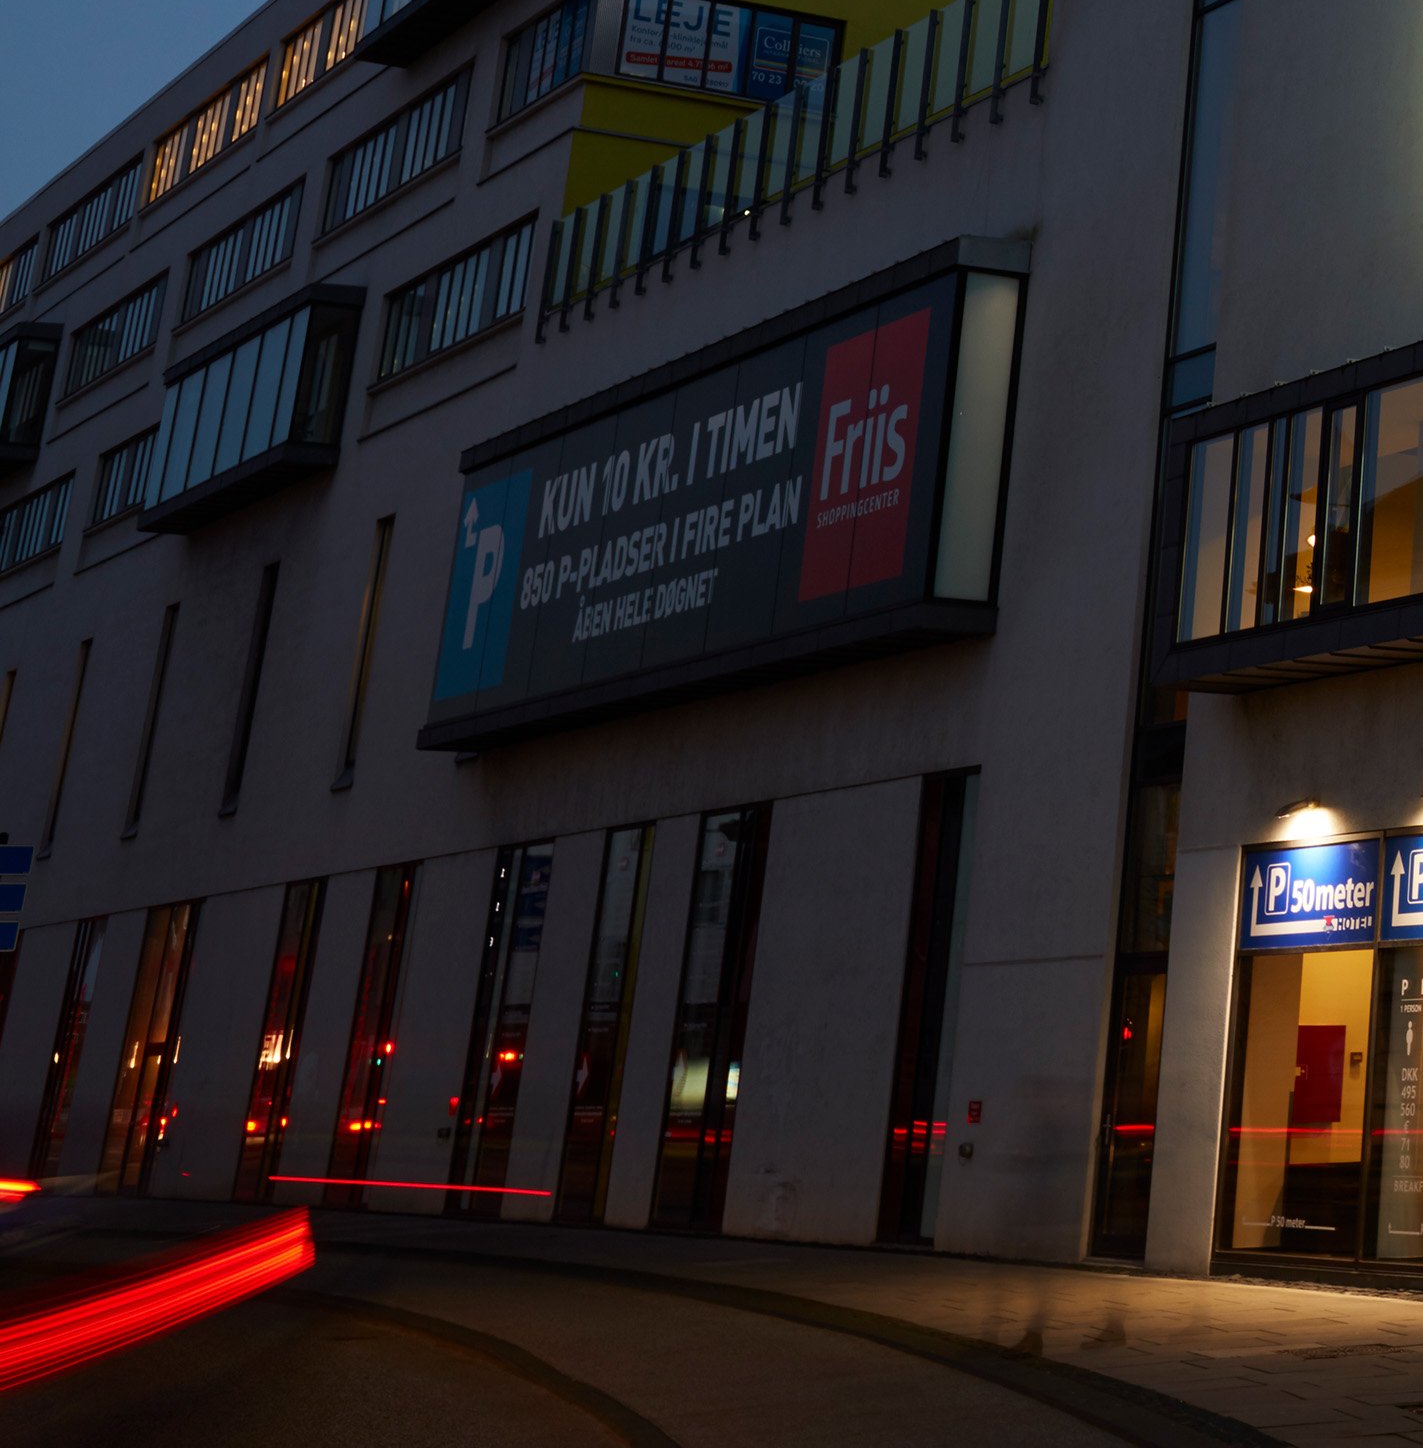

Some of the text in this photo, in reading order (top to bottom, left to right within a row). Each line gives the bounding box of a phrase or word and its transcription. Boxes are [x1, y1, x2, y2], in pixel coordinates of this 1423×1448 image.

[768, 74, 783, 85] 23
[819, 384, 908, 502] Friis
[538, 382, 803, 539] KUN 10 KR. I TIMEN
[816, 488, 900, 529] SHOPPINGCENTER
[520, 561, 554, 610] 850
[557, 525, 667, 599] P-PLADSER
[681, 499, 734, 559] FIRE
[737, 476, 803, 543] PLAN
[462, 524, 505, 650] P
[572, 568, 719, 643] ÅBEN HELE DØGNET
[1268, 867, 1287, 912] P
[1404, 1004, 1422, 1013] PERSON
[1401, 1068, 1418, 1081] DKK
[1401, 1085, 1416, 1099] 495
[1400, 1103, 1416, 1117] 560
[1401, 1138, 1410, 1151] 71
[1400, 1155, 1410, 1169] 80
[1270, 1215, 1306, 1228] P 50 meter
